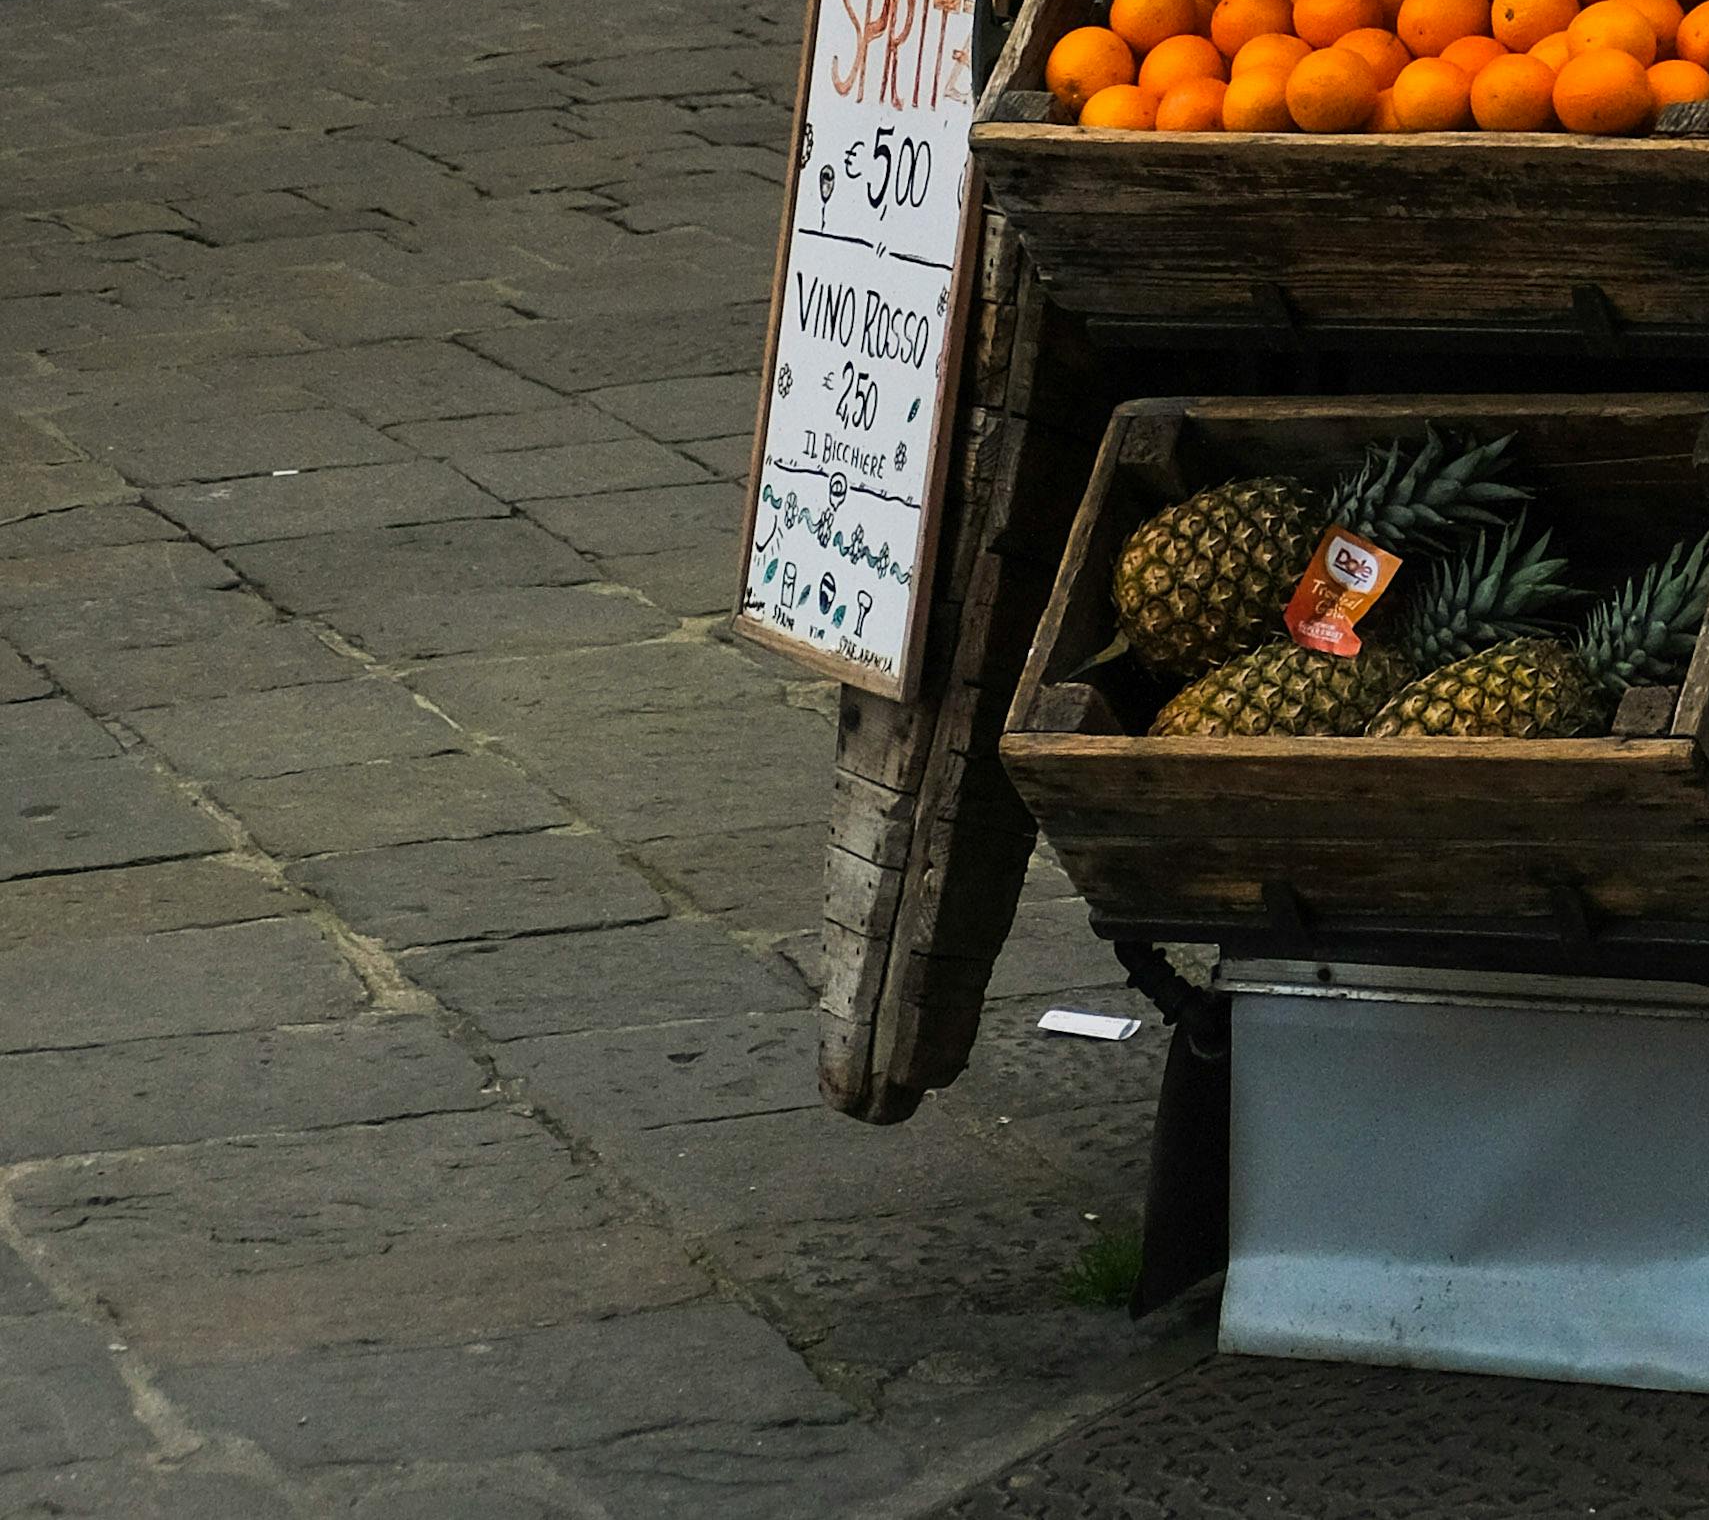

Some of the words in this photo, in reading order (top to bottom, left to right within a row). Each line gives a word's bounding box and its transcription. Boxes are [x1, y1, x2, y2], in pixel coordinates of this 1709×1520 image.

[797, 271, 856, 348] VINO
[861, 289, 930, 370] ROSSO
[802, 430, 818, 459] IL
